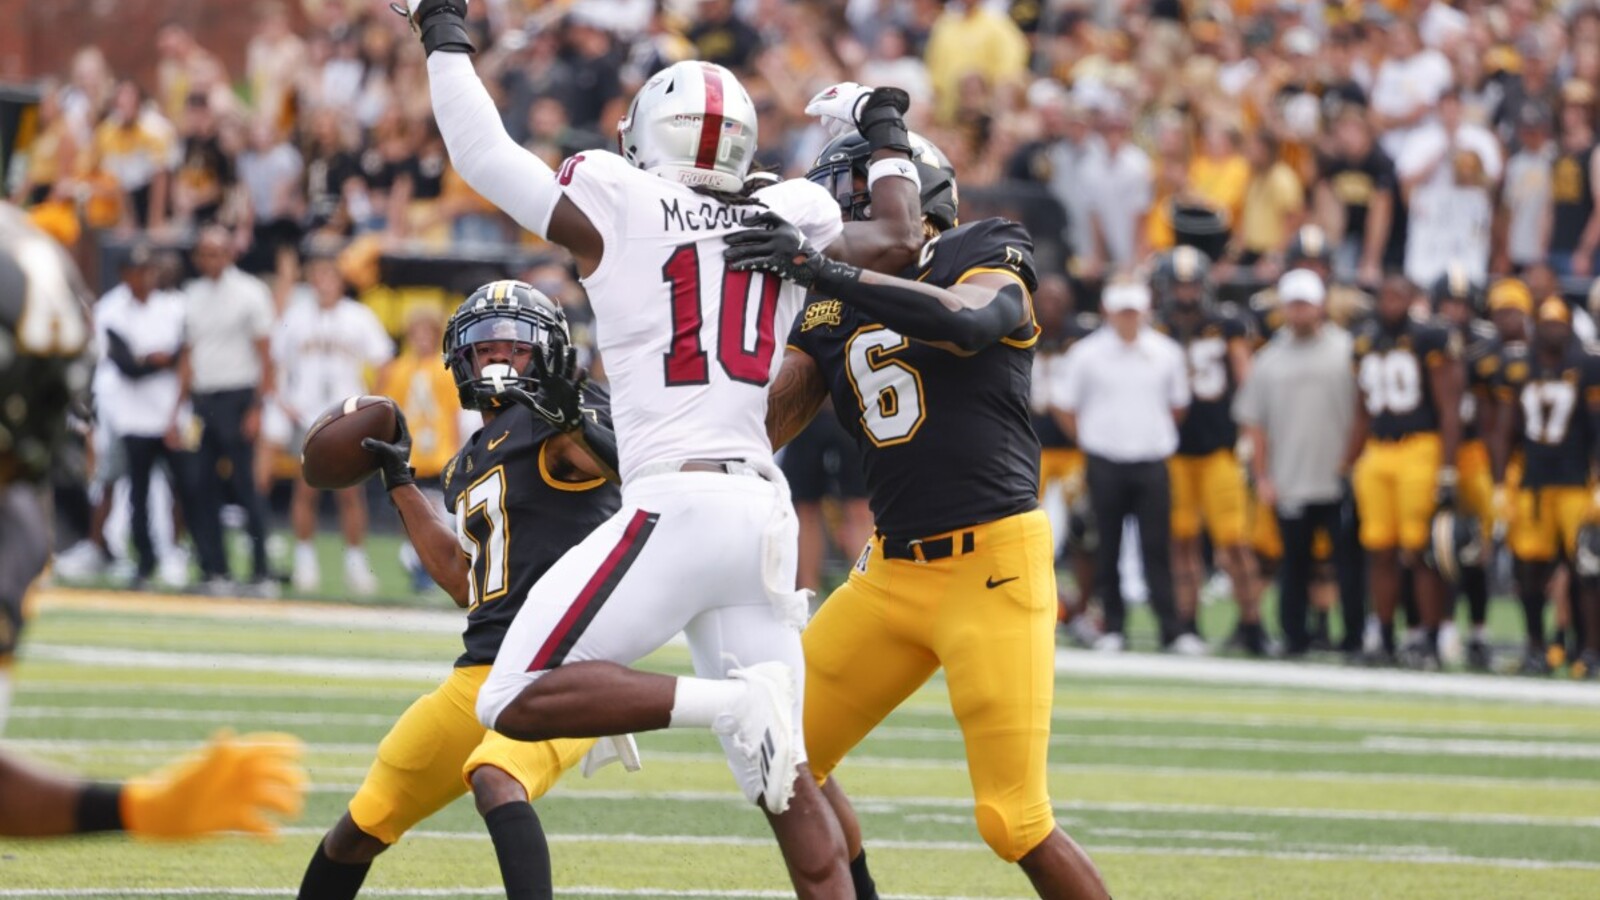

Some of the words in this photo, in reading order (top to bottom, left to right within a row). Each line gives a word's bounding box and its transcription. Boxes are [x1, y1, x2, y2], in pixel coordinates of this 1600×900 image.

[679, 169, 725, 188] TROJANS
[661, 242, 783, 388] 10
[844, 323, 927, 448] 6
[1520, 379, 1577, 443] 17
[454, 464, 511, 612] 17
